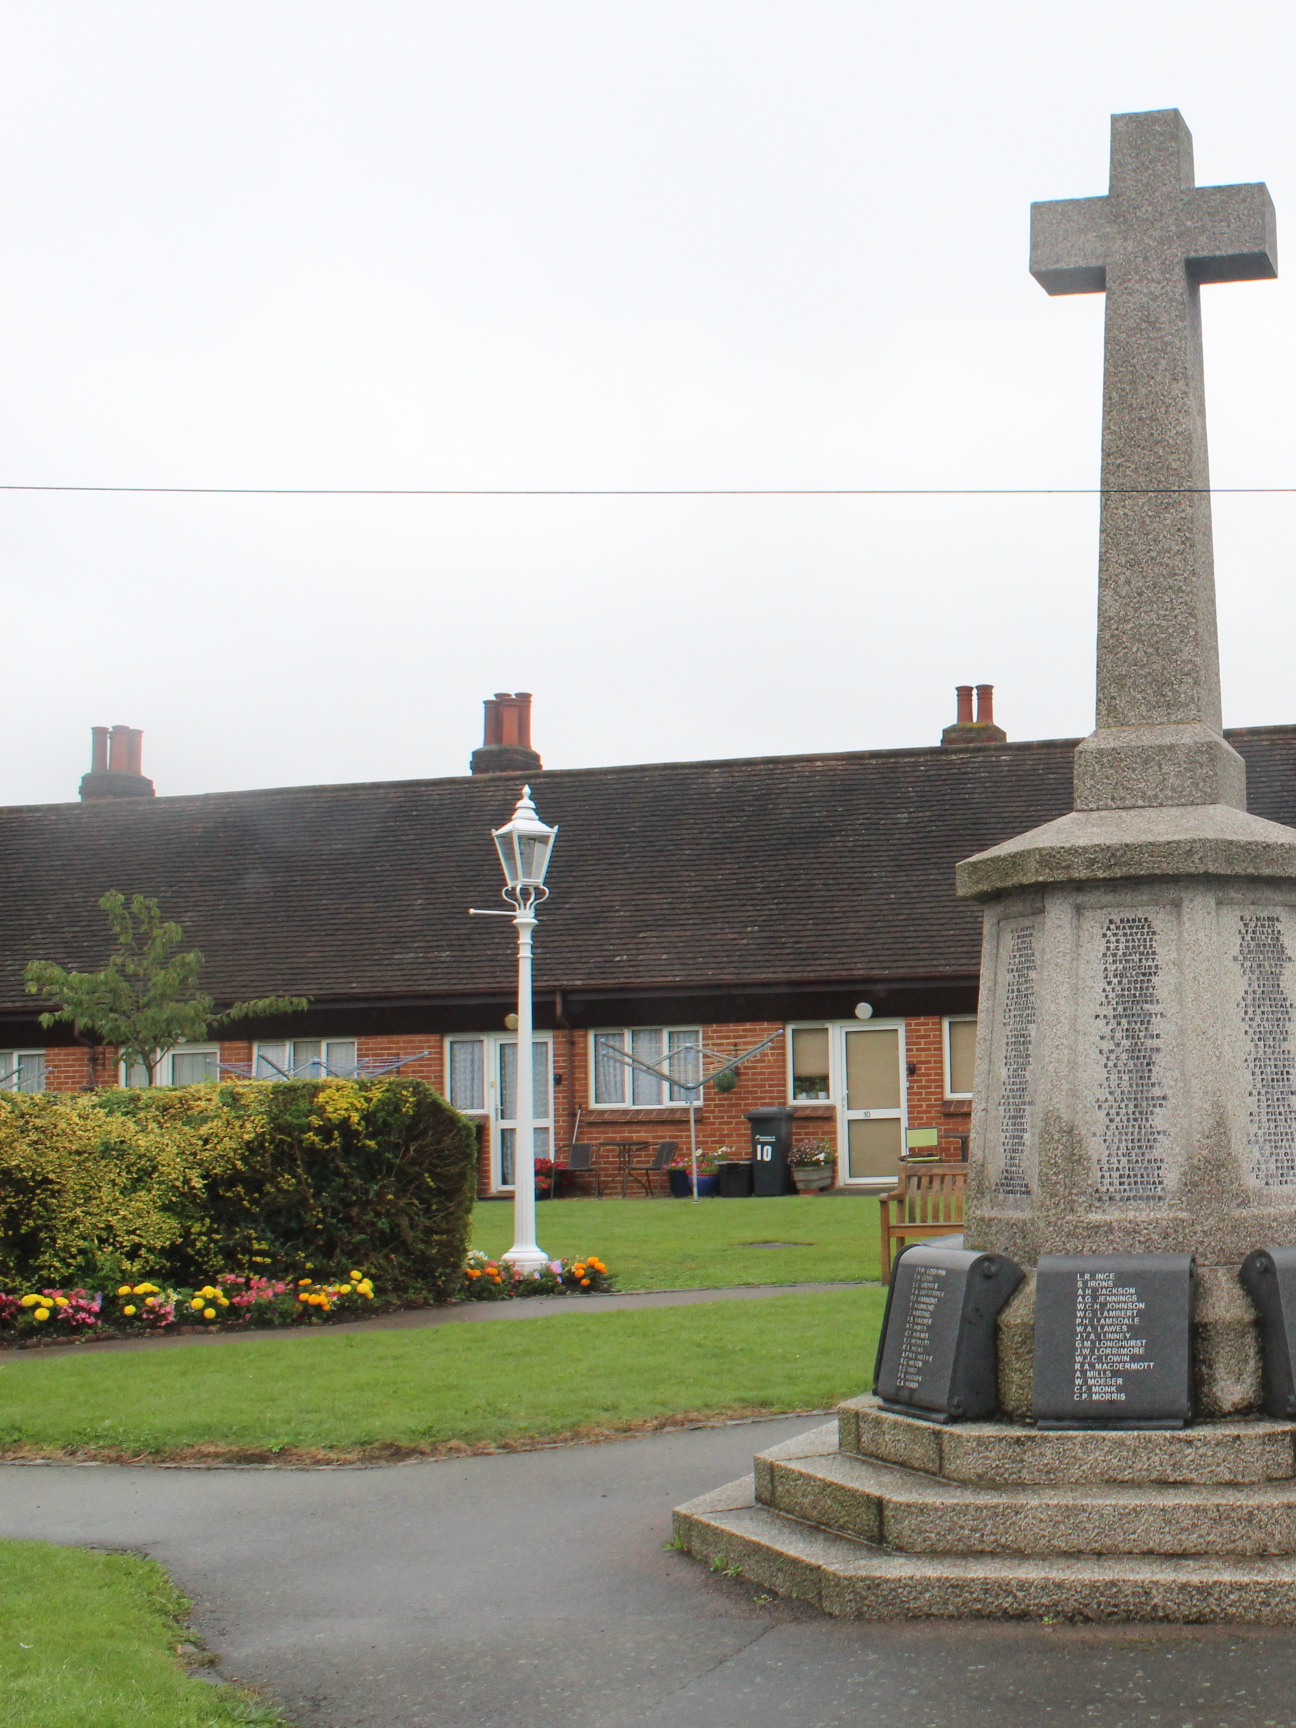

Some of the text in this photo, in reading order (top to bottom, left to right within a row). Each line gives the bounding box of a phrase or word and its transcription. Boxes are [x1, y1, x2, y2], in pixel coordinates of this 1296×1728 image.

[756, 1144, 772, 1161] 10
[1097, 1287, 1136, 1295] JACKSON
[1105, 1302, 1145, 1310] JOHNSON
[1094, 1317, 1140, 1325] LAMSDALE
[1094, 1347, 1145, 1355] LORRIMORE
[1095, 1362, 1154, 1370] MACDERMOTT
